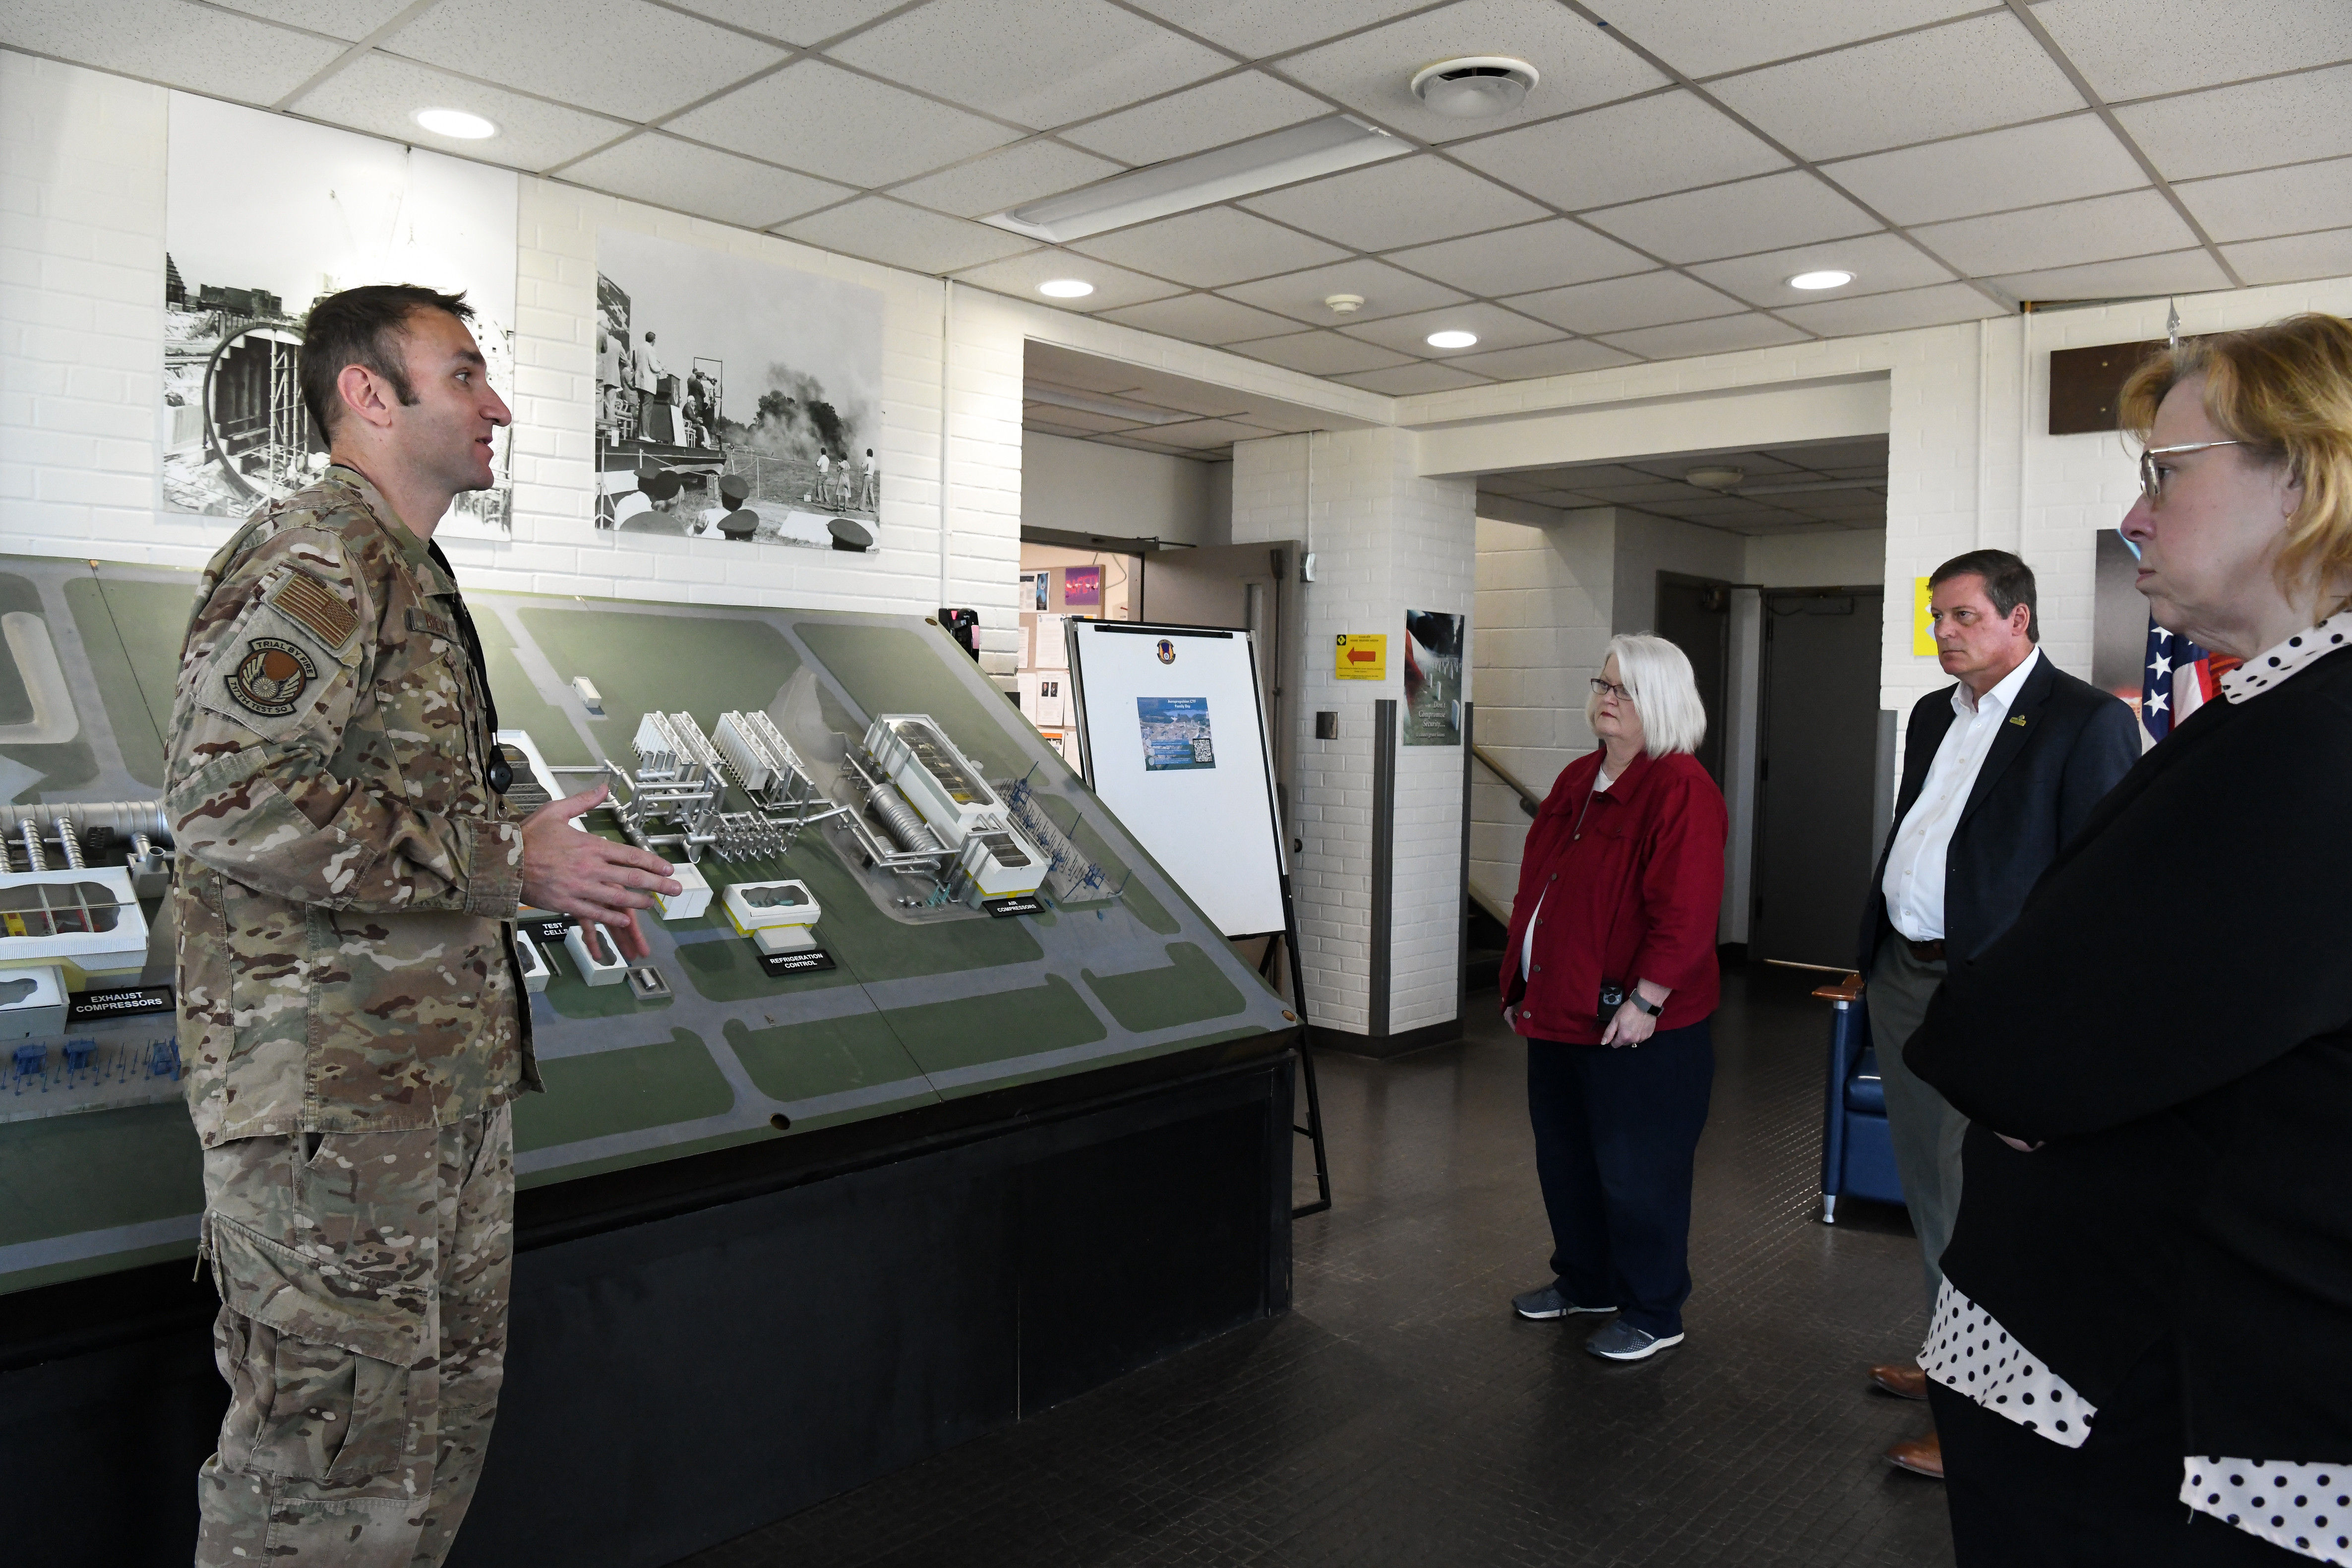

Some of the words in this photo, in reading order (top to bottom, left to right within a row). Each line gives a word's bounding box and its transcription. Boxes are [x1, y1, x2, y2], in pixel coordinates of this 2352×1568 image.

[256, 641, 285, 650] TRIAL
[288, 646, 302, 656] BY
[300, 657, 313, 674] FIRE
[231, 681, 250, 704] 717TH
[252, 703, 272, 713] TEST
[1419, 710, 1446, 720] Compromise
[997, 904, 1036, 912] COMPRESSORS
[769, 953, 824, 964] REFRIGERATION
[784, 960, 818, 968] CONTROL
[90, 992, 143, 1003] EXHAUST
[76, 998, 163, 1013] COMPRESSORS
